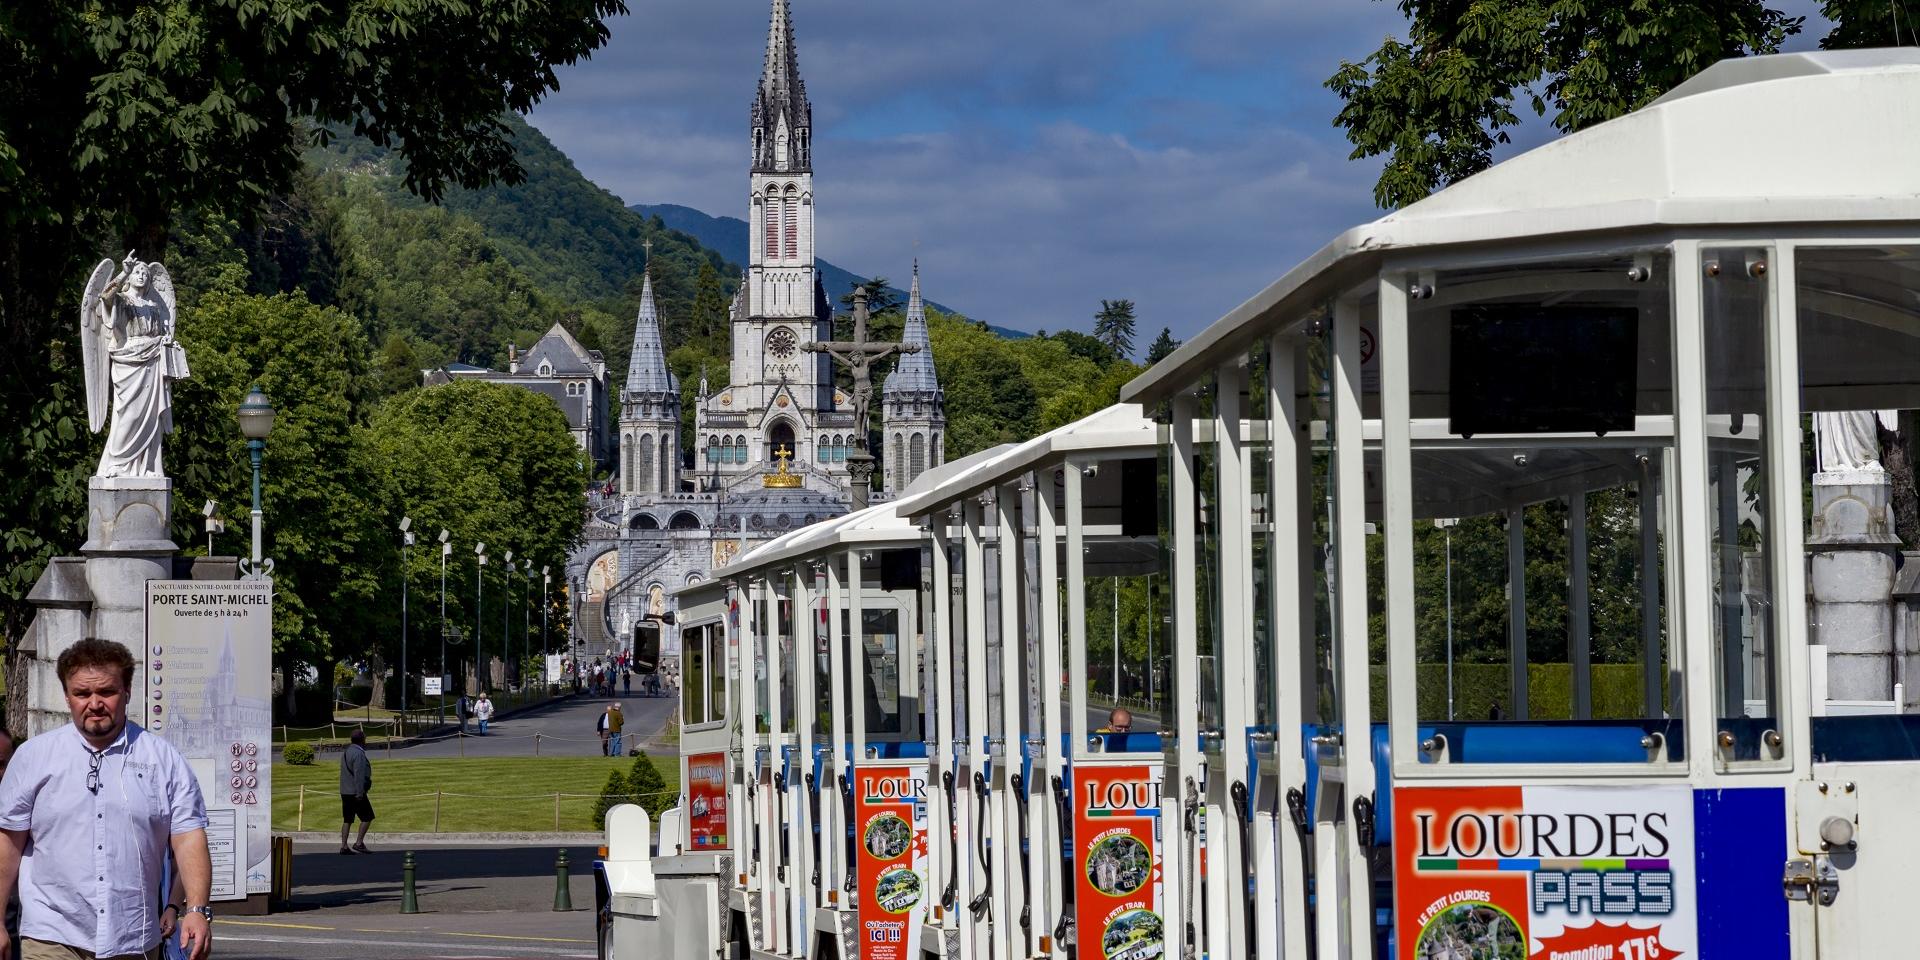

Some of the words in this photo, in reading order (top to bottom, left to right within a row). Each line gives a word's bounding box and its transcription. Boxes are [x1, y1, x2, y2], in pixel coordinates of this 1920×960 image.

[152, 594, 188, 605] PORTE
[190, 594, 269, 605] SAINT-MICHEL
[174, 609, 203, 617] Ouverte
[203, 609, 213, 617] de
[865, 778, 927, 798] LOUR
[1093, 832, 1106, 845] PETIT
[1106, 827, 1132, 837] LOURDES
[1416, 812, 1670, 858] LOURDES
[1534, 870, 1673, 914] PASS
[1102, 917, 1111, 927] LE
[1108, 904, 1125, 919] PETIT
[1124, 901, 1146, 910] TRAIN
[1417, 912, 1430, 928] LE
[1425, 895, 1449, 918] PETIT
[1448, 889, 1491, 905] LOURDES
[870, 929, 886, 941] ICI
[889, 929, 901, 941] !!!
[1618, 934, 1660, 960] 17€
